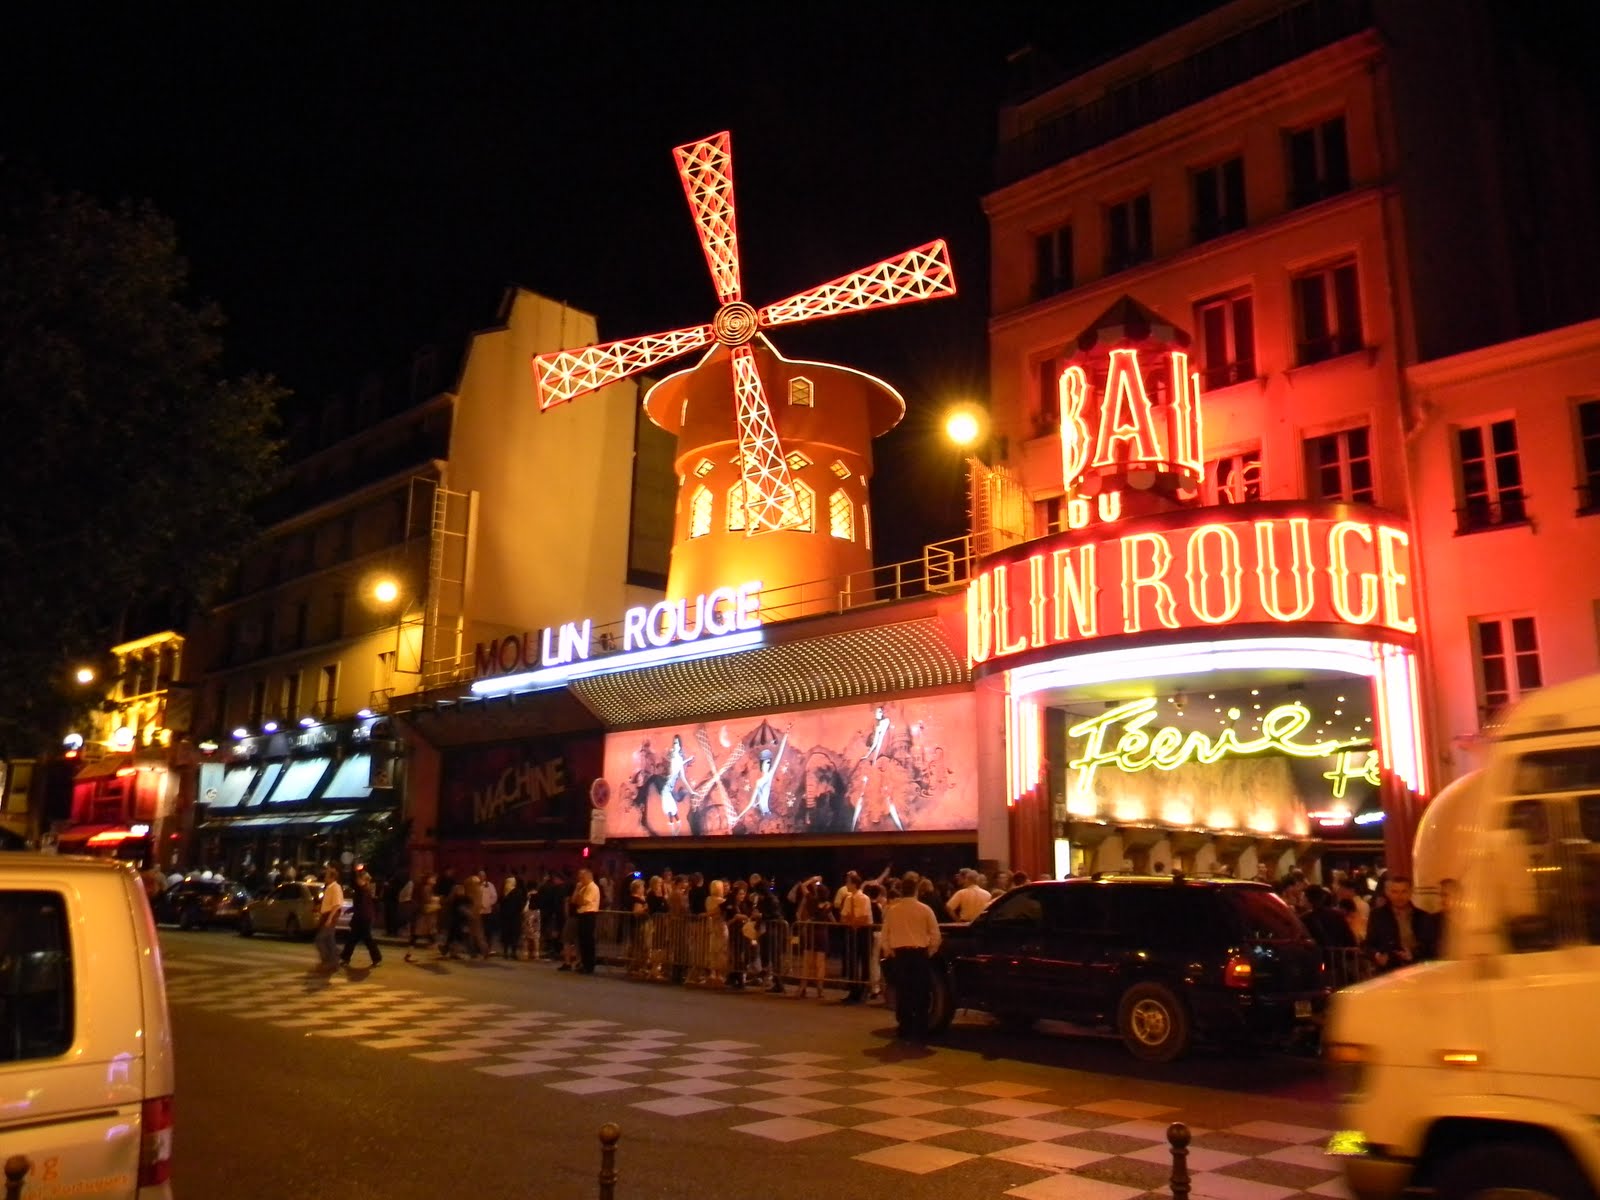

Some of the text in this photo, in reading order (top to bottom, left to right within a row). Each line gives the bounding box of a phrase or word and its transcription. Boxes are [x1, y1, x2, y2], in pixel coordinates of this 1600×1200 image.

[1059, 349, 1205, 492] BAL
[475, 580, 764, 677] MOULIN ROUGE
[1120, 518, 1418, 634] ROUGE
[473, 756, 568, 826] MACHINE
